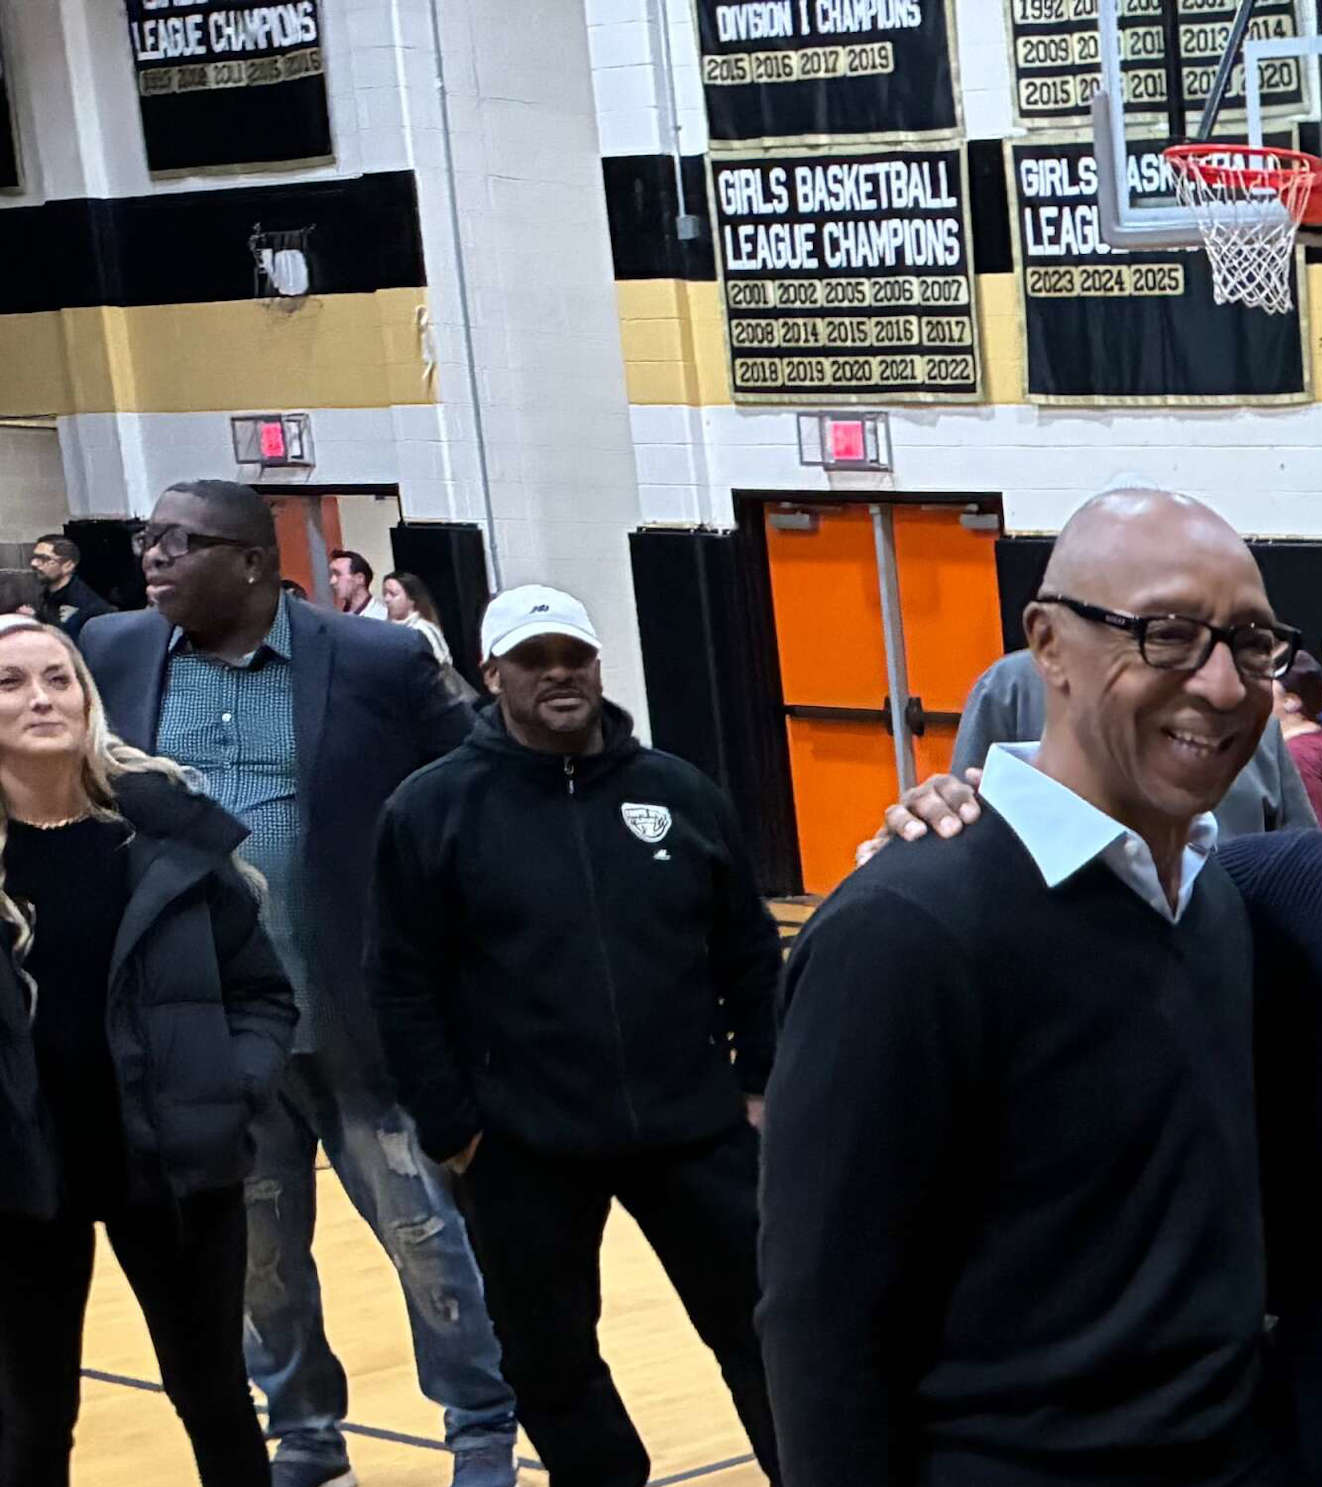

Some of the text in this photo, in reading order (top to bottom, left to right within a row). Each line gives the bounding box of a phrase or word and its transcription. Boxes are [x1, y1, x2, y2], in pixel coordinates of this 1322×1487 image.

[131, 2, 317, 61] LEAGUE CHAMPIONS
[716, 0, 793, 42] DIVISION
[816, 0, 922, 35] CHAMPIONS
[755, 53, 794, 79] 2016
[800, 50, 841, 75] 2017
[847, 45, 891, 72] 2019
[1023, 37, 1069, 63] 2009
[1130, 29, 1165, 56] 201
[1183, 26, 1230, 53] 2013
[1025, 81, 1071, 106] 2015
[1132, 71, 1167, 98] 201
[718, 160, 957, 215] GIRLS BASKETBALL
[1020, 156, 1097, 197] GIRLS
[723, 218, 961, 271] LEAGUE CHAMPIONS
[1024, 205, 1115, 256] LEAG
[730, 279, 962, 306] 2001 2002 2005 2006 2007
[1030, 268, 1179, 293] 2023 2024 2025
[734, 317, 966, 345] 2008 2014 2015 2016 2017
[740, 357, 970, 383] 2018 2019 2020 2021 2022
